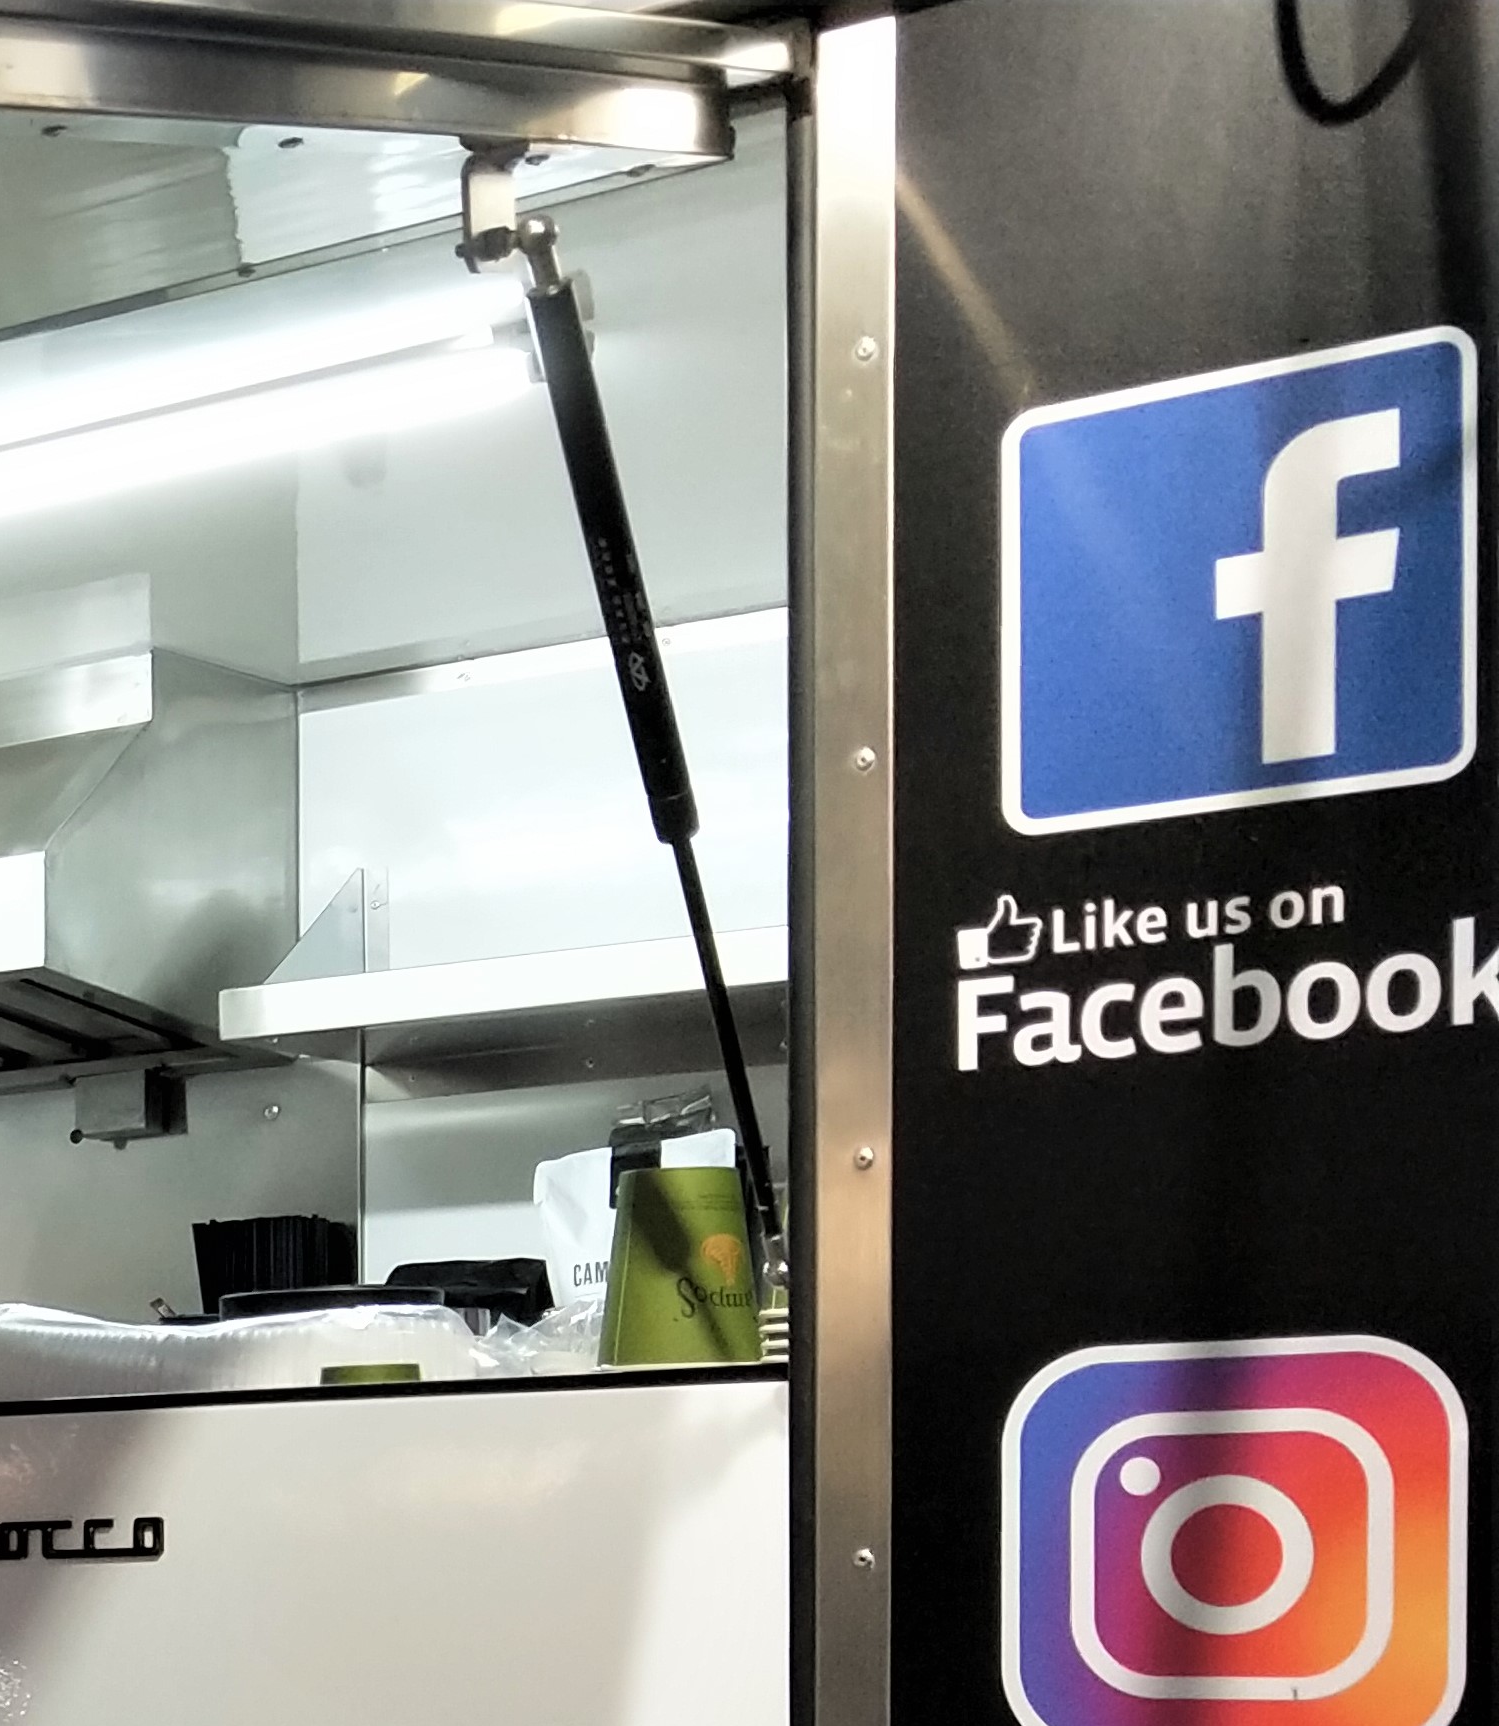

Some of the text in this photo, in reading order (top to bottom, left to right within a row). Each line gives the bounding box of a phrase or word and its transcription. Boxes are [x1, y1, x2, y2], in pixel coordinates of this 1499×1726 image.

[1051, 885, 1345, 954] Like us on
